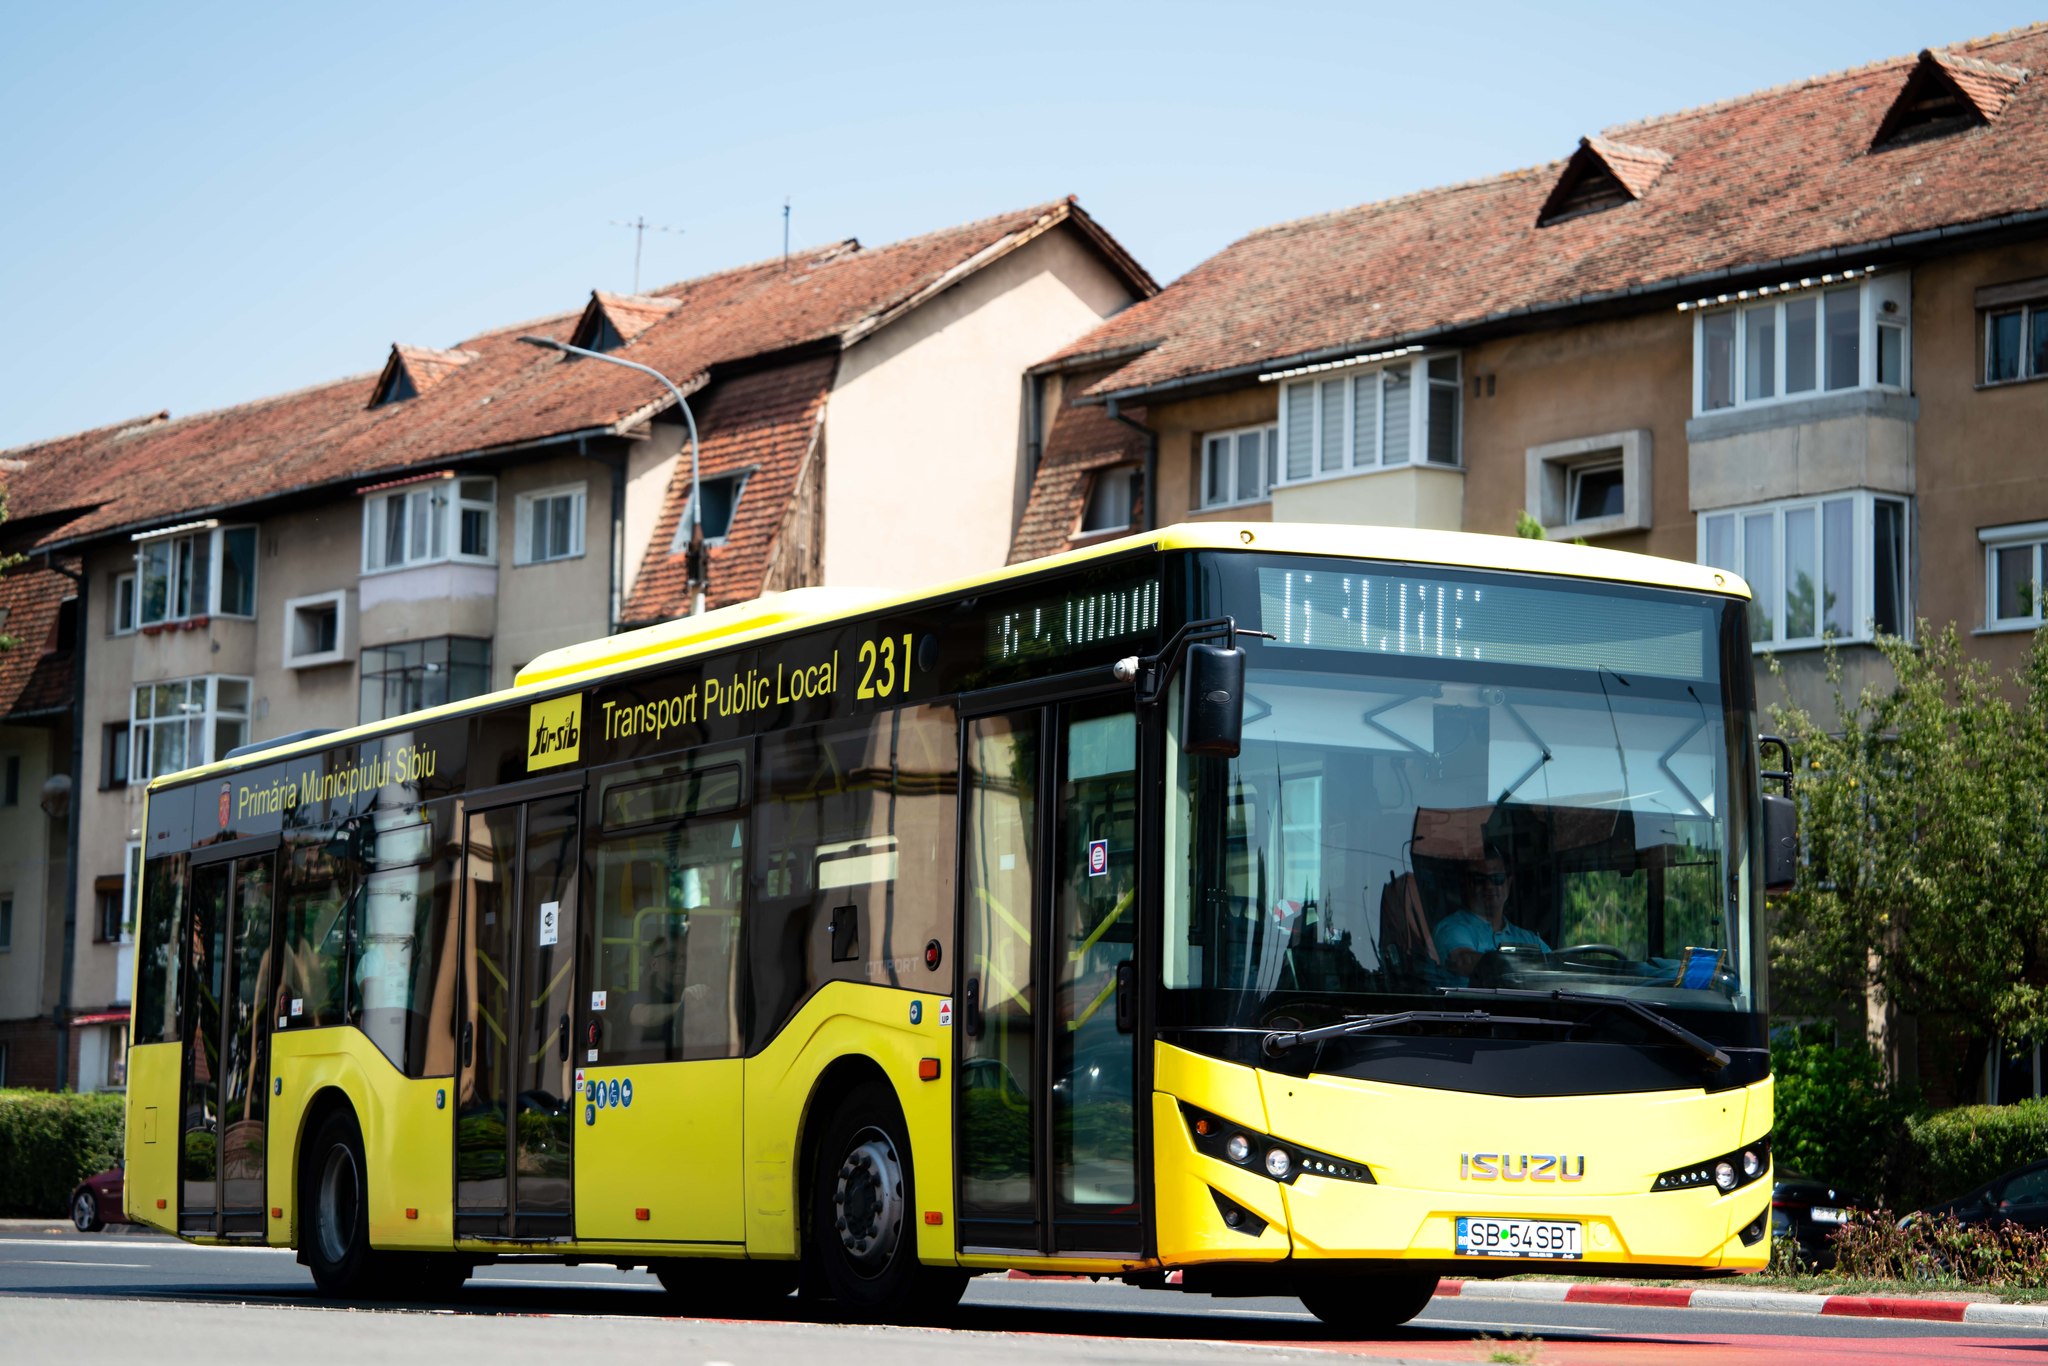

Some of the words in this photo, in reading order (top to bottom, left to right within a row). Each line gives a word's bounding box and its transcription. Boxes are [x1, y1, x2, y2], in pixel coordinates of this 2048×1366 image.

[601, 683, 698, 742] Transport
[703, 668, 770, 721] Public
[776, 649, 839, 706] Local
[856, 633, 913, 701] 231
[237, 776, 297, 820] Primăria
[301, 751, 391, 805] Municipiului
[395, 742, 437, 784] Sibiu
[941, 1015, 949, 1024] UP
[1460, 1152, 1585, 1182] ISUZU
[1458, 1235, 1468, 1246] RO
[1536, 1225, 1576, 1250] SBT
